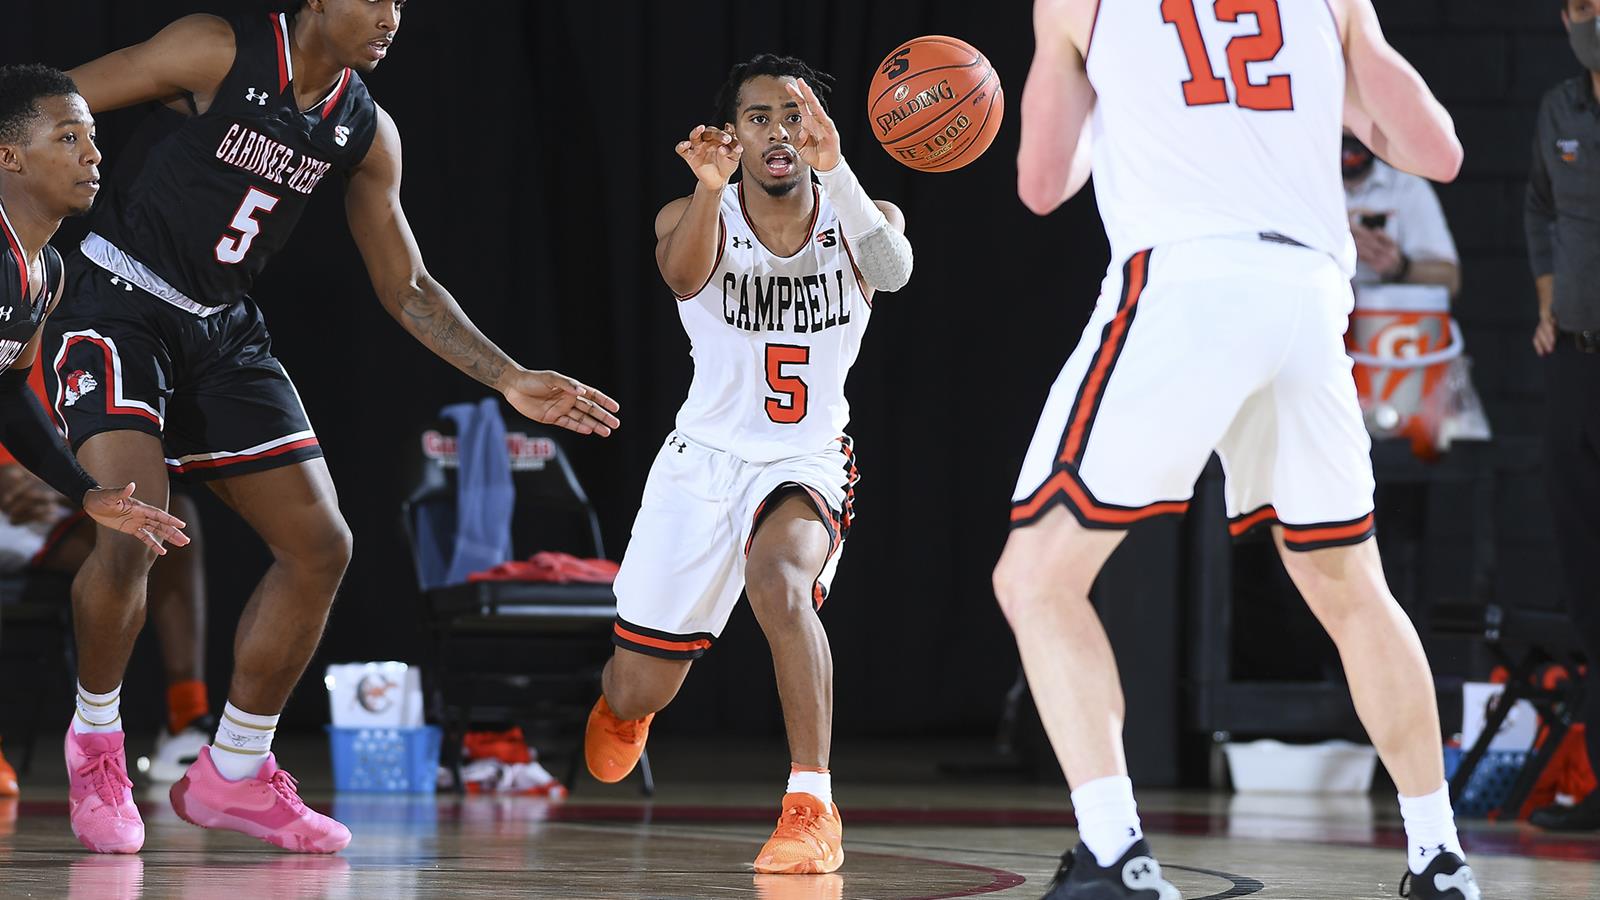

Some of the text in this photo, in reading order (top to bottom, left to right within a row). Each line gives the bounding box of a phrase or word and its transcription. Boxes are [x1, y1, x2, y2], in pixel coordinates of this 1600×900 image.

[1160, 0, 1294, 111] 12
[876, 79, 956, 136] SPALDING
[214, 185, 280, 264] 5
[723, 270, 850, 333] CAMPBELL
[764, 343, 810, 424] 5
